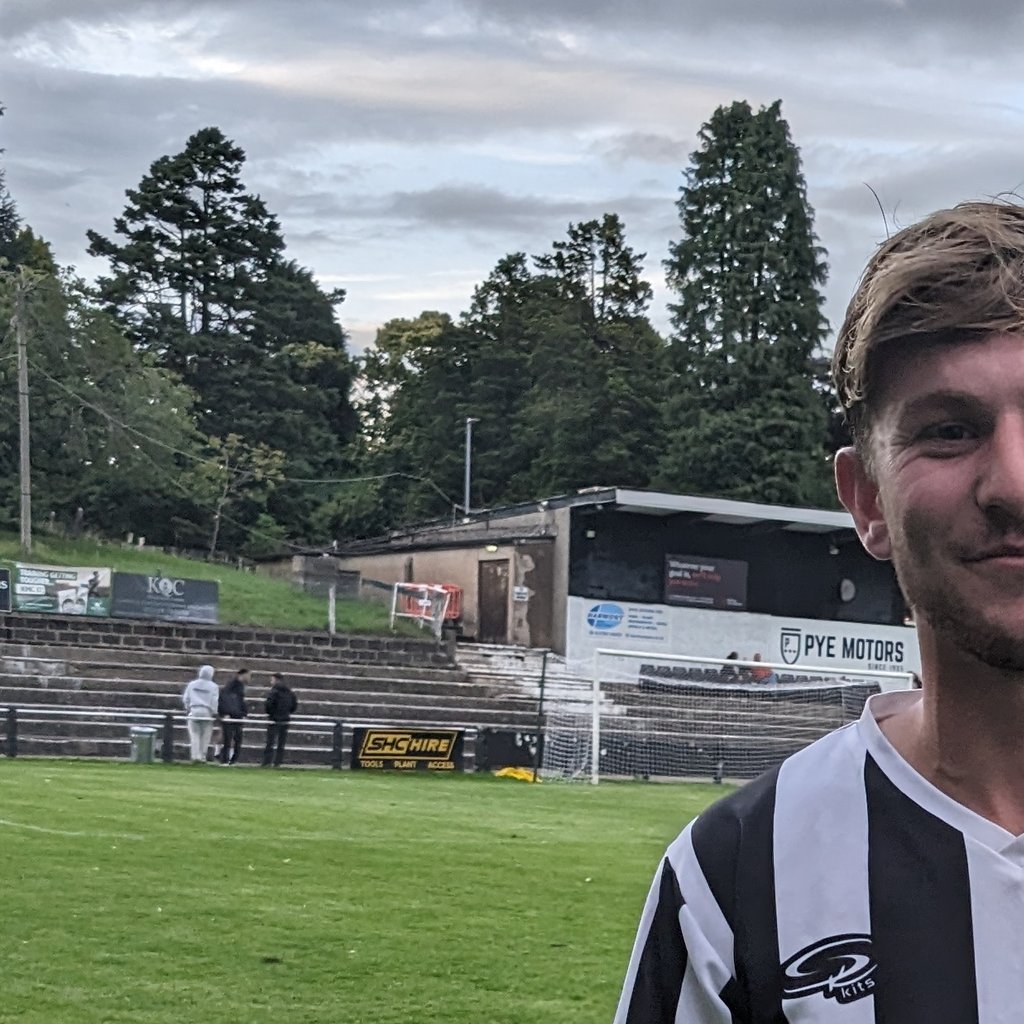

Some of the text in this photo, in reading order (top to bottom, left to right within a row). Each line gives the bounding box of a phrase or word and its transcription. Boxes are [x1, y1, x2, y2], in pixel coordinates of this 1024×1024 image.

[804, 634, 904, 663] PYE MOTORS
[409, 738, 450, 753] HIRE
[360, 760, 384, 769] TOOLS
[393, 760, 417, 769] PLANT
[841, 977, 876, 999] kits
